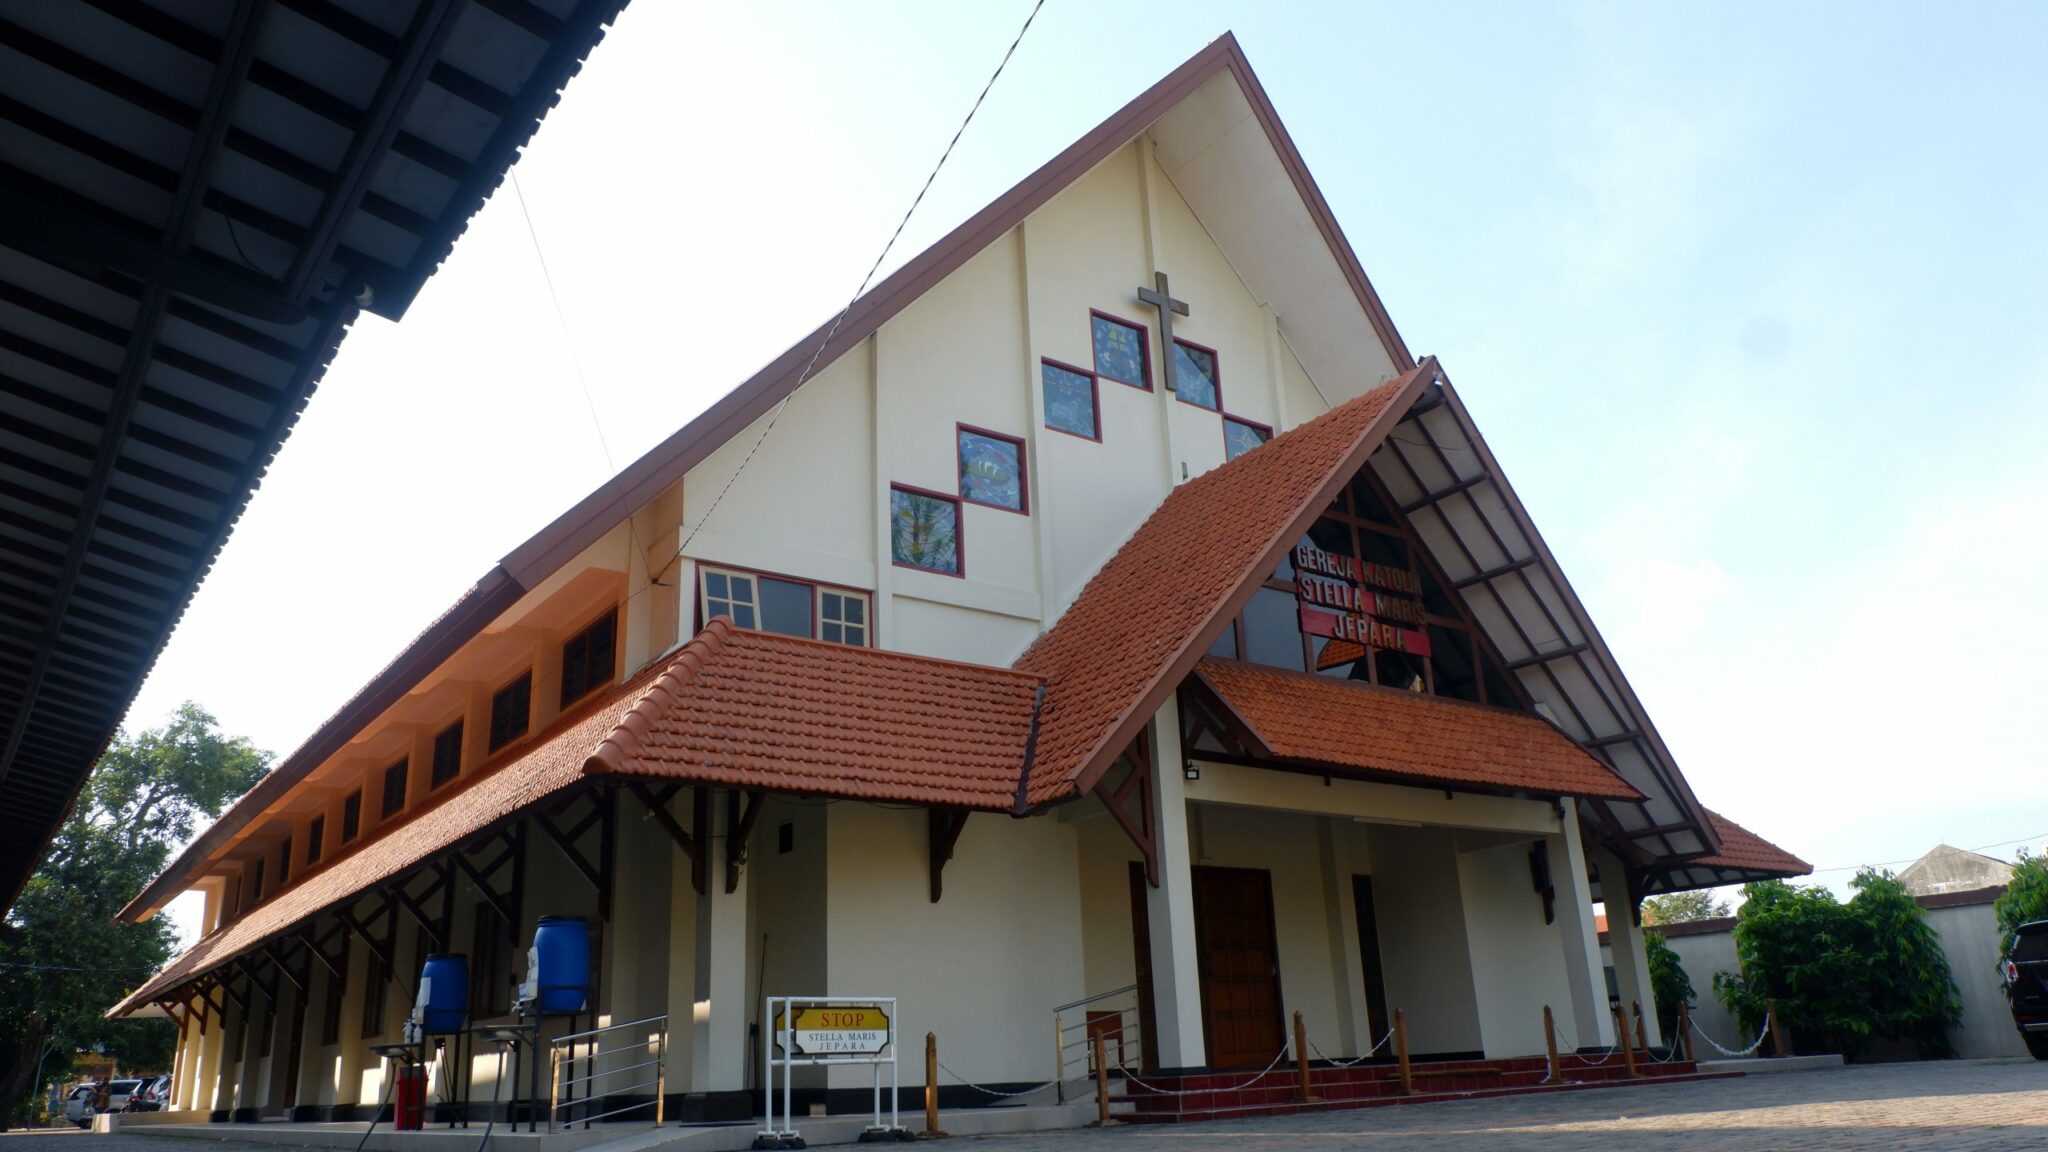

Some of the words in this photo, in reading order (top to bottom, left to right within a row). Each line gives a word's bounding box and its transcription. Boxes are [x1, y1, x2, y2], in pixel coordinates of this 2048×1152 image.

[1296, 545, 1357, 579] GEREJA
[1363, 560, 1423, 594] KATOLIK
[1302, 577, 1364, 612] STELLA
[1375, 591, 1426, 624] MARIS
[1335, 615, 1405, 651] JEPARA
[821, 1013, 864, 1027] STOP
[809, 1033, 843, 1041] STELLA
[848, 1032, 877, 1040] MARIS
[820, 1042, 865, 1050] JEPARA
